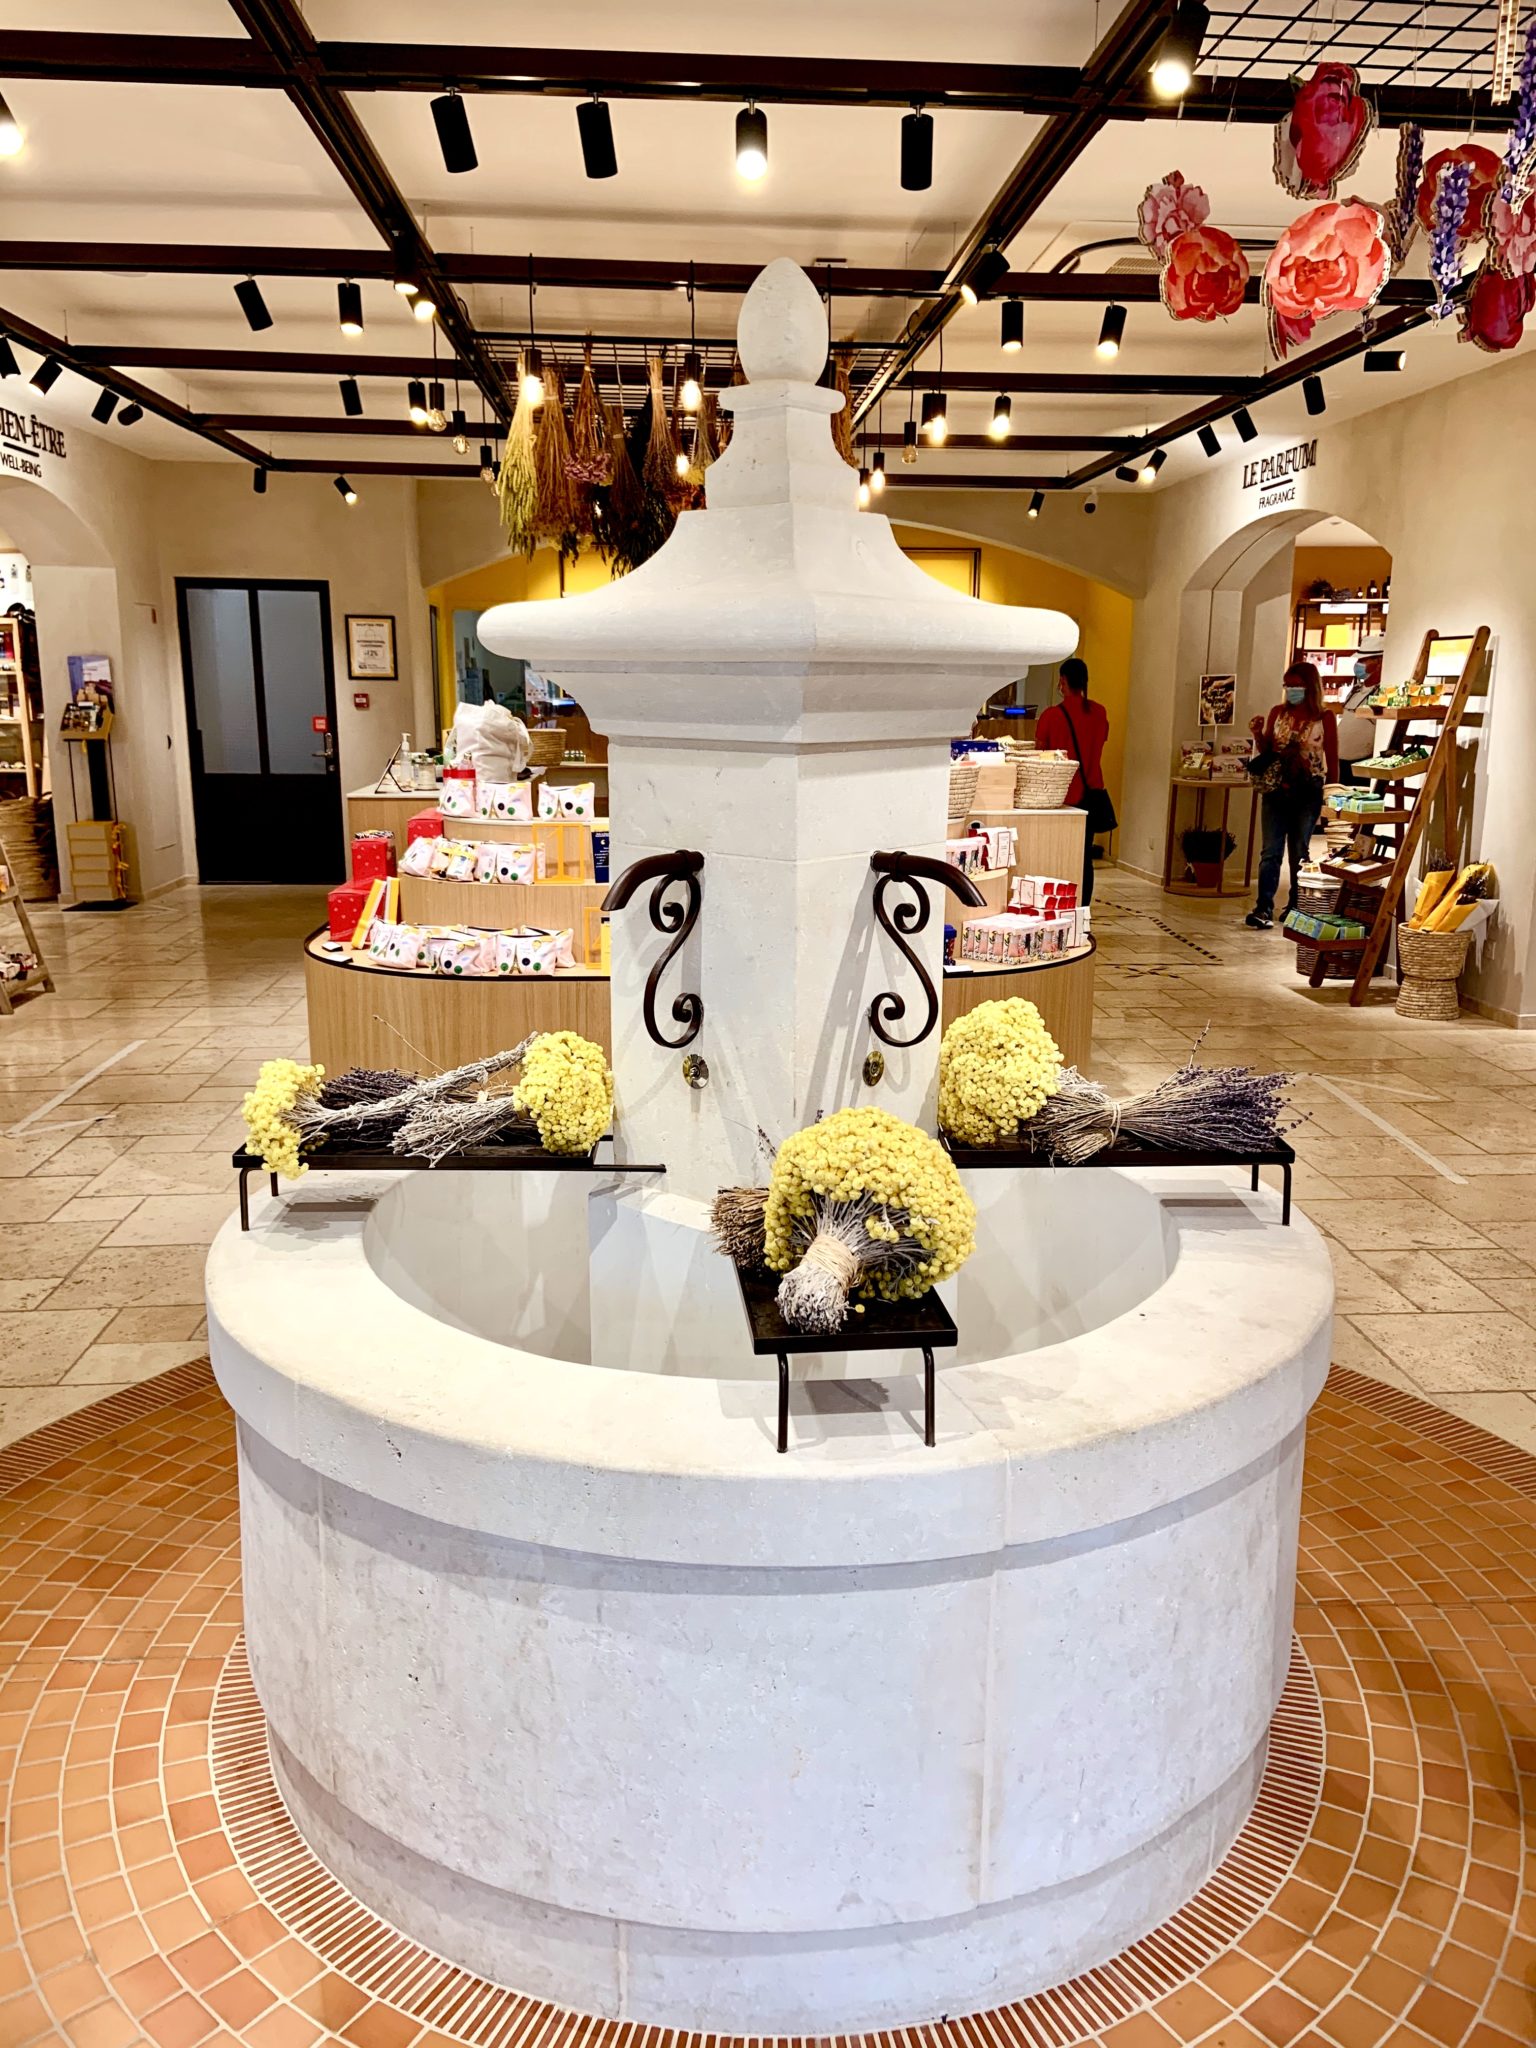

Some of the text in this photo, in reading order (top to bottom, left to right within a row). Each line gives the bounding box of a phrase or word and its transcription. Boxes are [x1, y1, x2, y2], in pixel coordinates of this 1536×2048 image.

[0, 407, 67, 459] IEN-ÊTRE
[0, 452, 42, 478] WELL-BEING
[1242, 439, 1318, 489] LE PARFUM
[1258, 487, 1296, 510] FRAGRANCE
